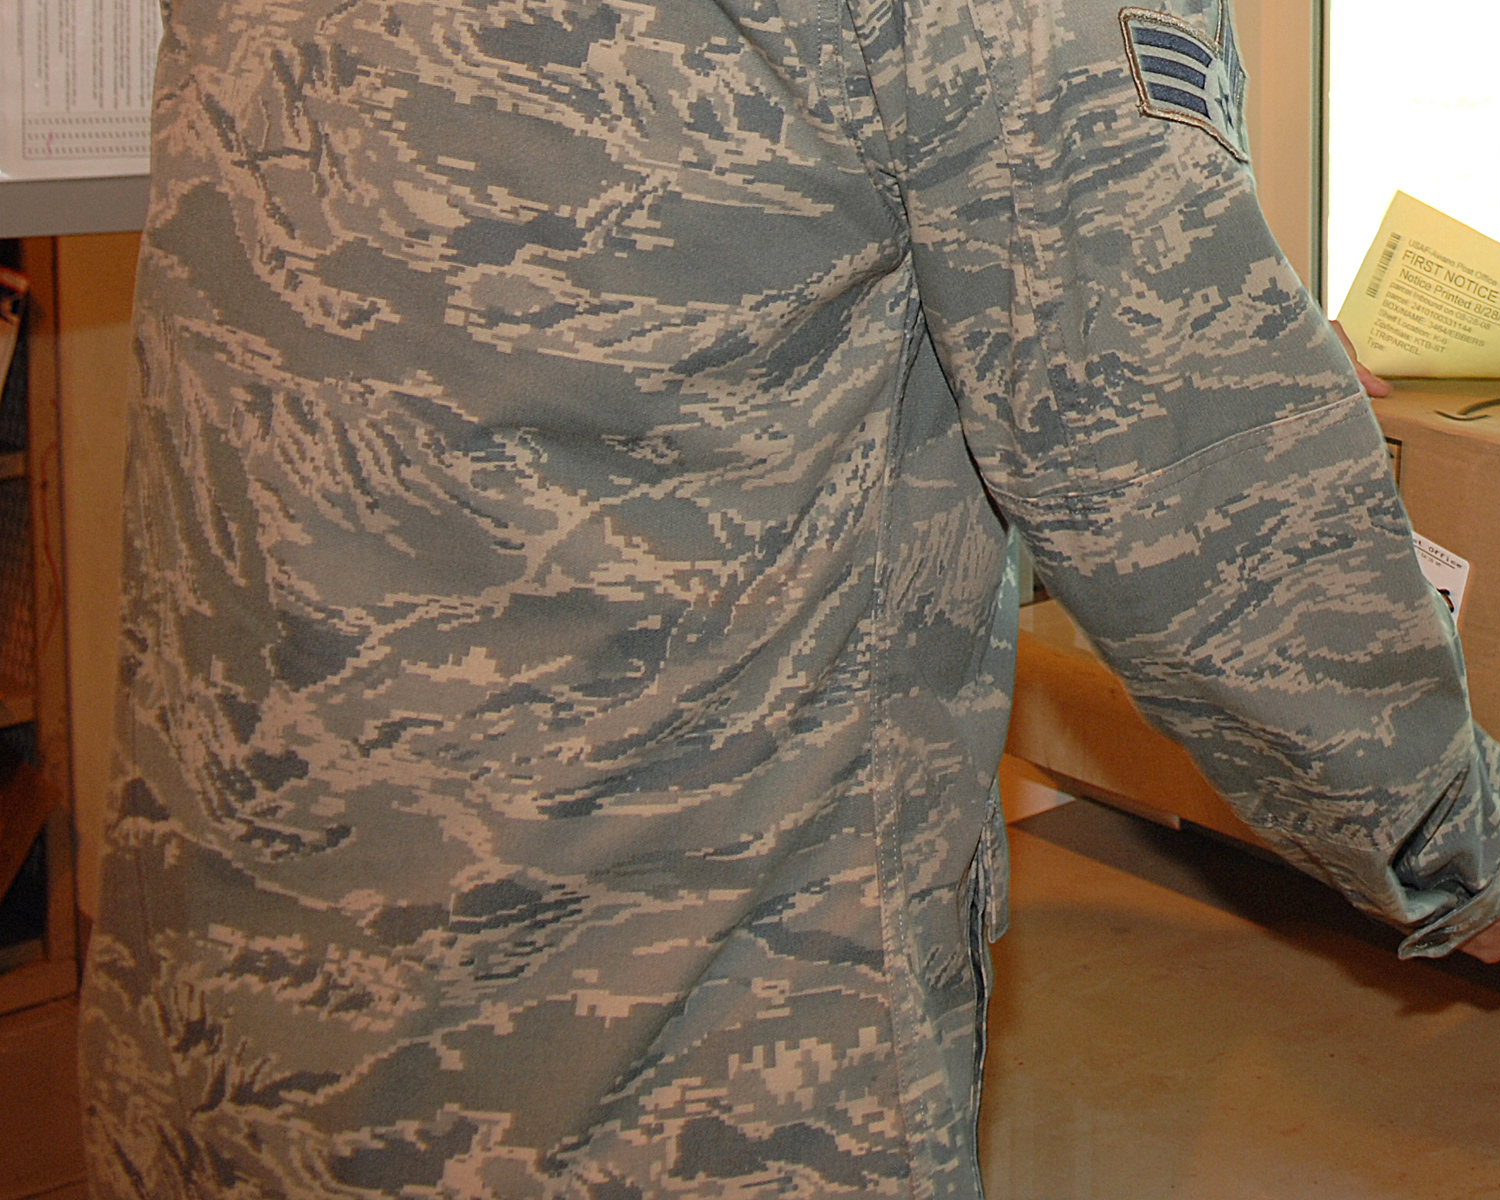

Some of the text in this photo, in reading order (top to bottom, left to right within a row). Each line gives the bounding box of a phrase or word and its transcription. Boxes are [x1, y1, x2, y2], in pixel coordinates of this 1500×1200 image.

[1399, 268, 1432, 291] Notice
[1433, 284, 1472, 310] Printed
[1402, 249, 1500, 303] FIRST NOTICE
[1457, 262, 1475, 275] Post
[1475, 270, 1498, 287] Office
[1428, 546, 1462, 569] Office
